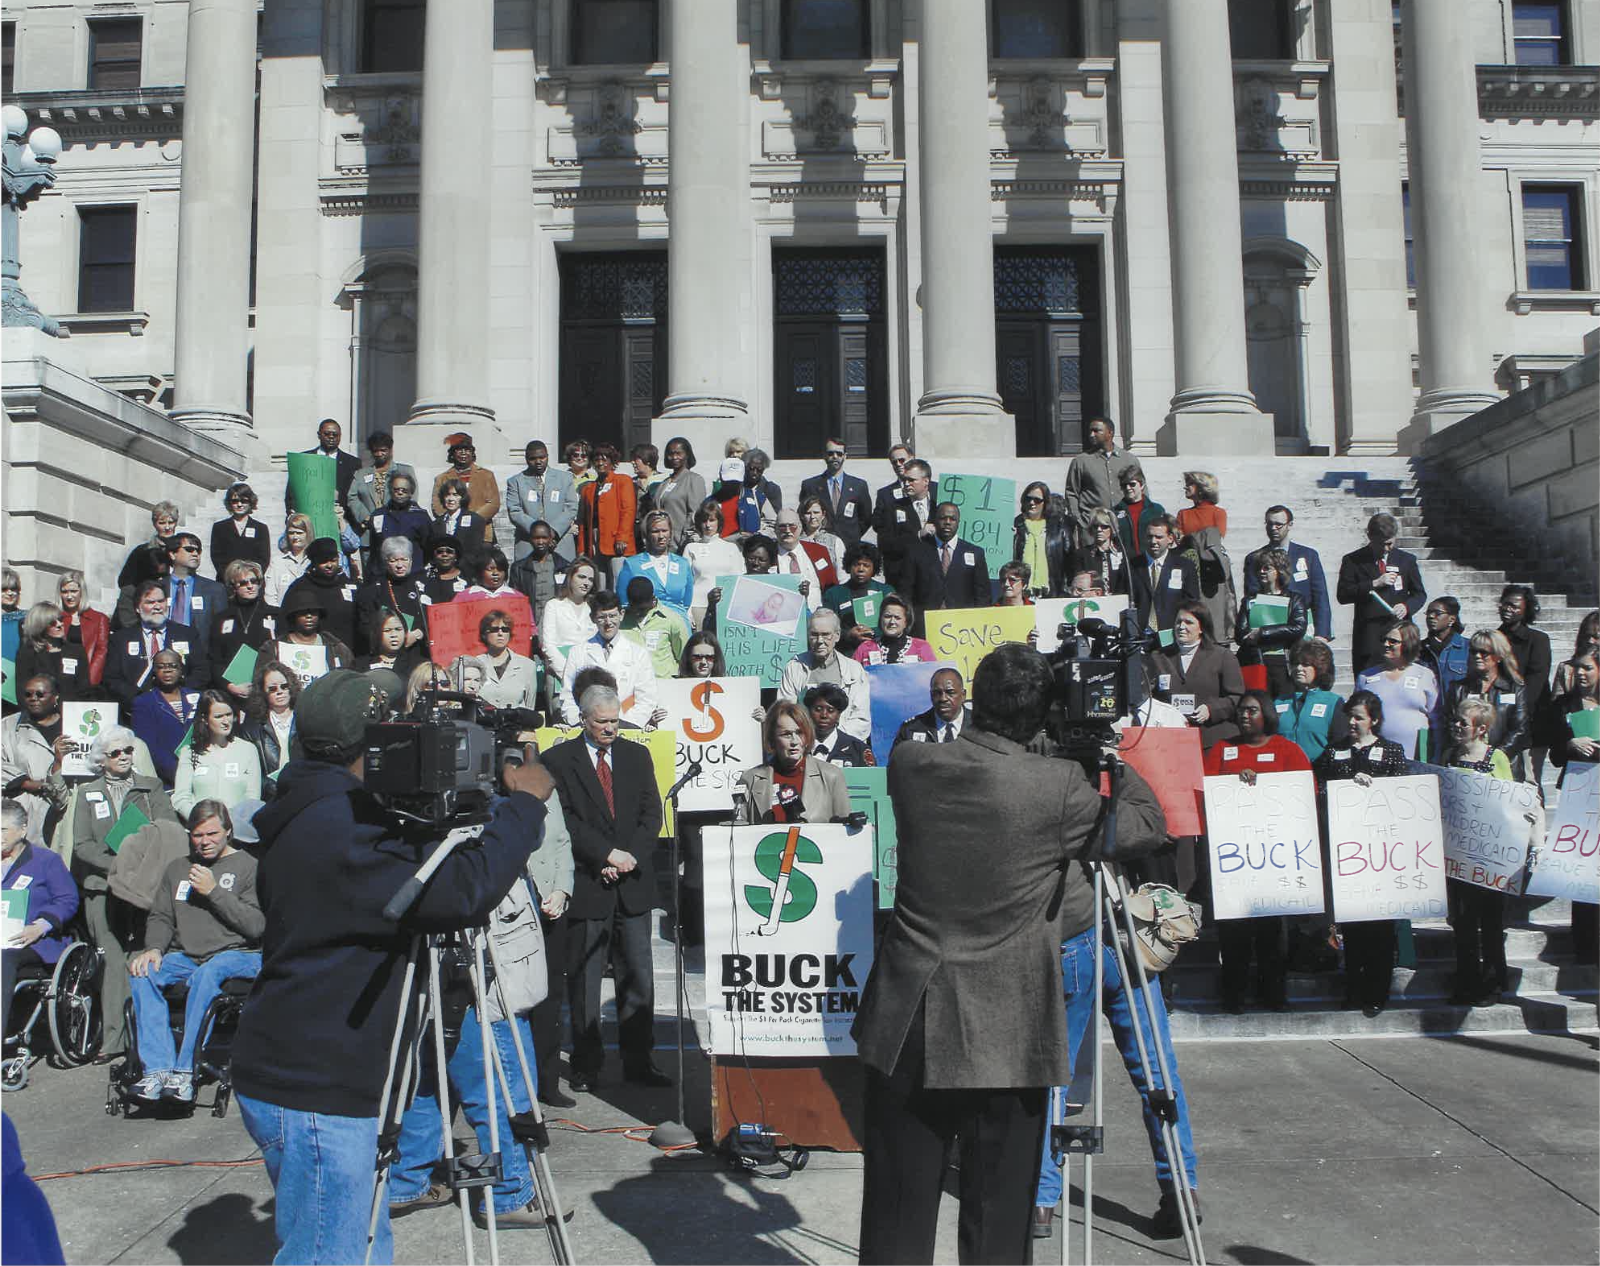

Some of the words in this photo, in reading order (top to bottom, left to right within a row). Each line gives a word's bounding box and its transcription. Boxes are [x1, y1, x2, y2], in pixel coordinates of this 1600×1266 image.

[762, 638, 801, 654] LIFE
[938, 622, 1007, 656] Save
[1336, 782, 1437, 822] PASS
[1365, 821, 1400, 840] THE
[1217, 839, 1319, 873] BUCK
[1337, 840, 1439, 876] BUCK
[1471, 866, 1518, 893] BUCK
[721, 953, 859, 988] BUCK
[722, 991, 766, 1013] THE
[770, 991, 859, 1013] SYSTEM
